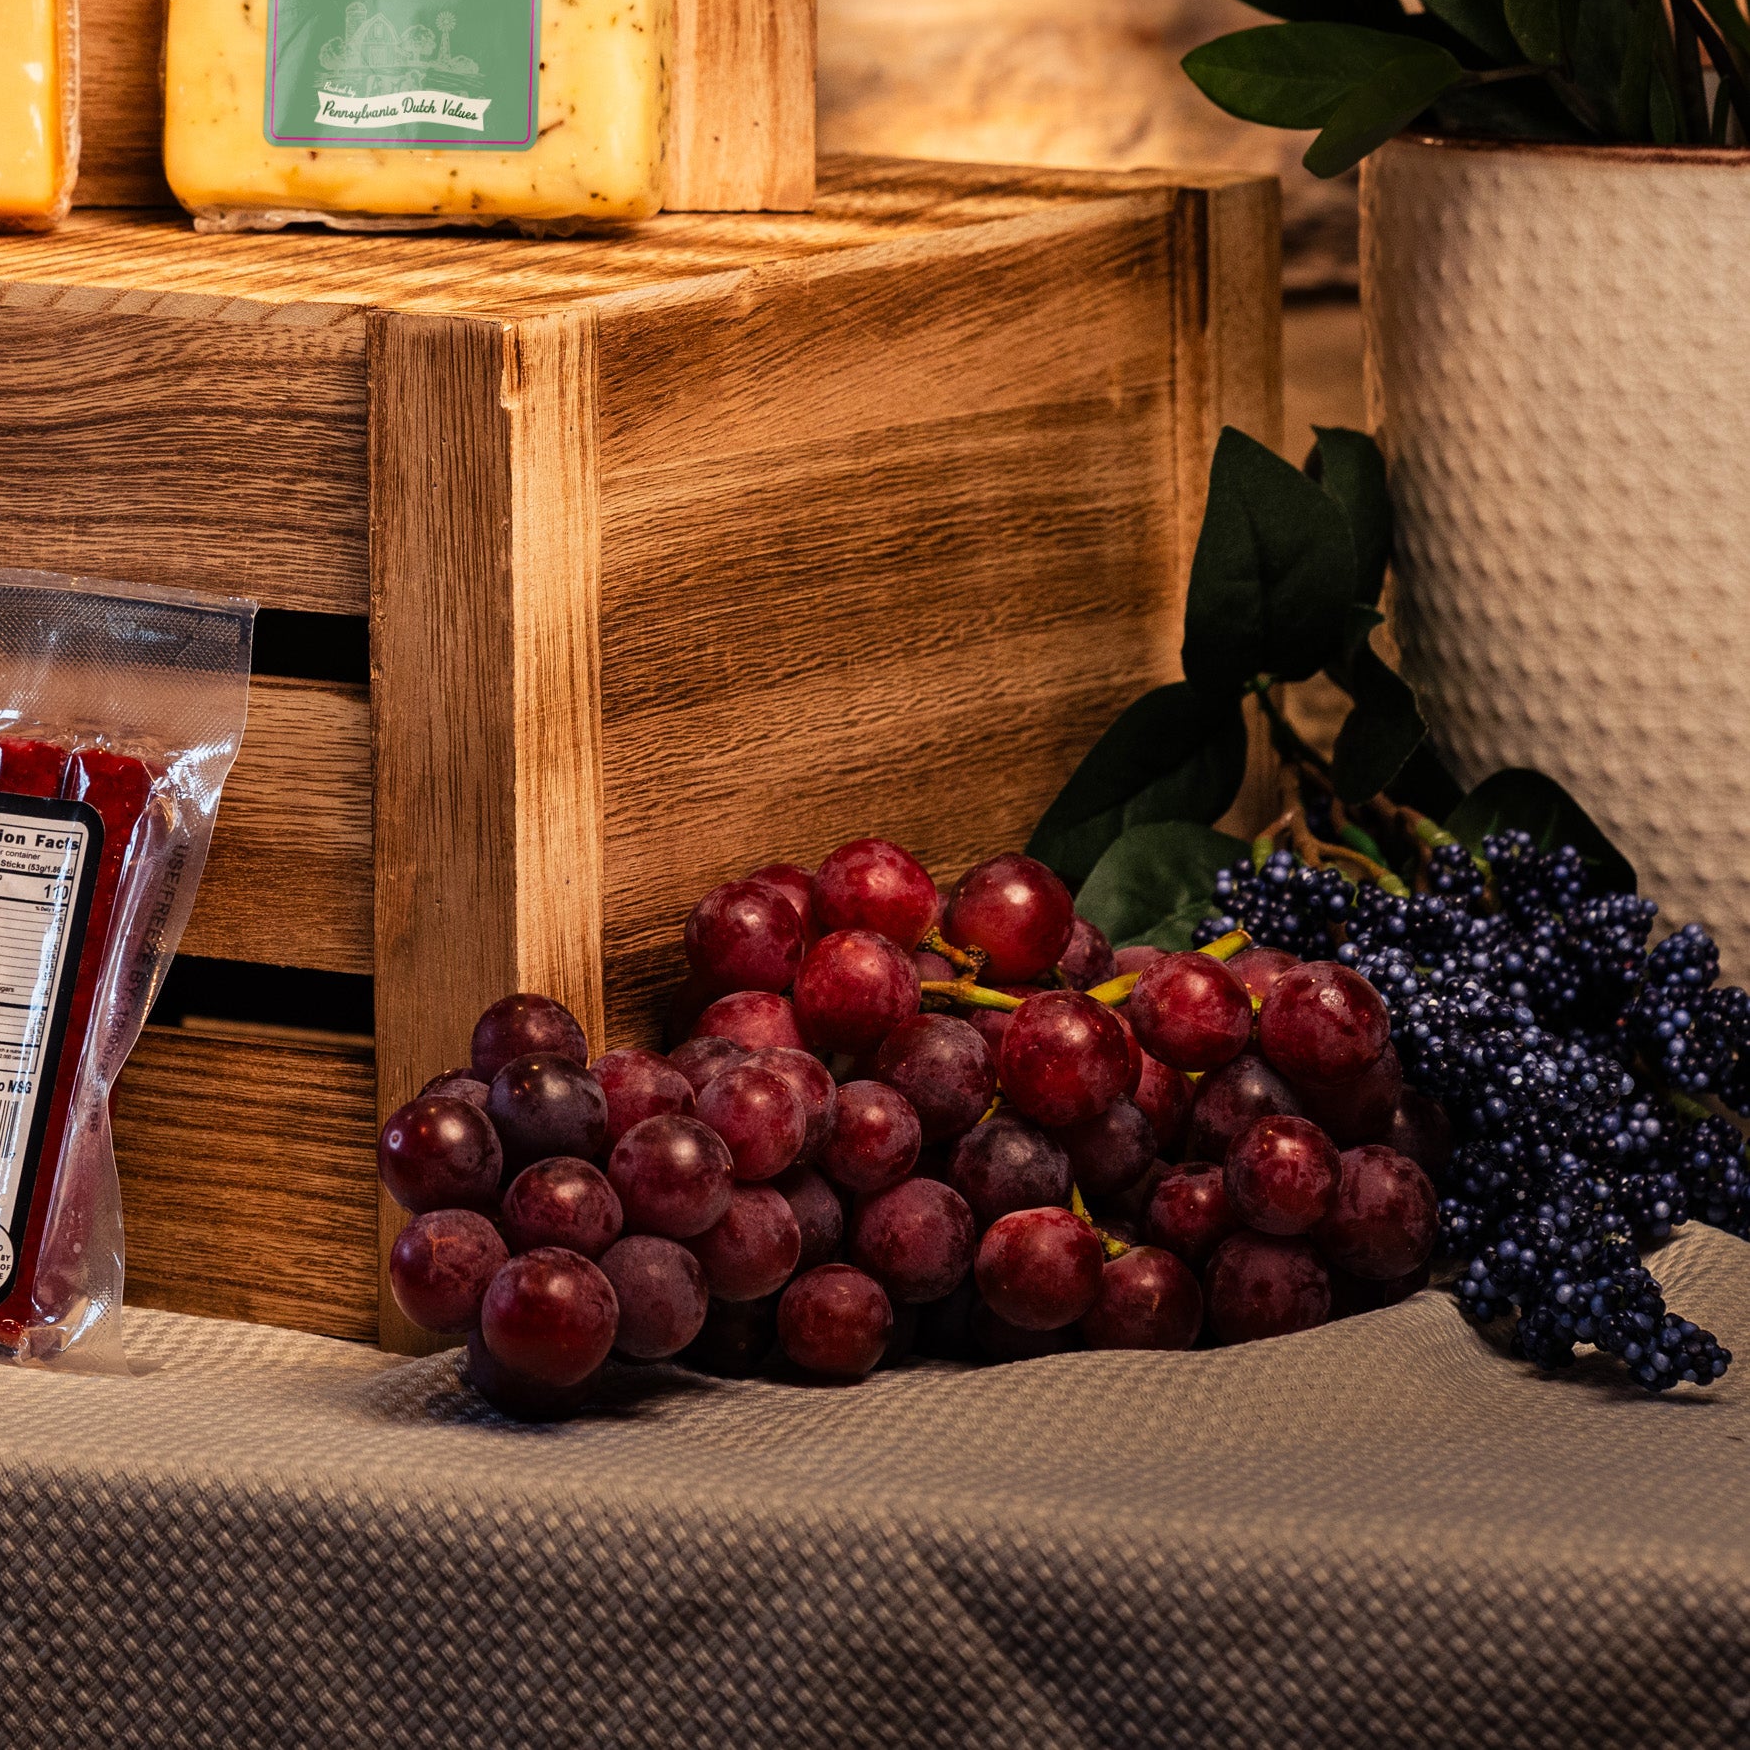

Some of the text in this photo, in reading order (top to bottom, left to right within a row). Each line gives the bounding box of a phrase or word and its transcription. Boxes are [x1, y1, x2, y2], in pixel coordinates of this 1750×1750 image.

[347, 86, 356, 97] by
[322, 97, 478, 123] Pennsylvania Dutch Values
[35, 834, 79, 850] Facts
[6, 848, 41, 861] container
[1, 859, 26, 871] Sticks
[44, 884, 69, 900] 110
[7, 1080, 32, 1094] MSG
[0, 1253, 11, 1262] BY
[0, 1263, 11, 1271] OF
